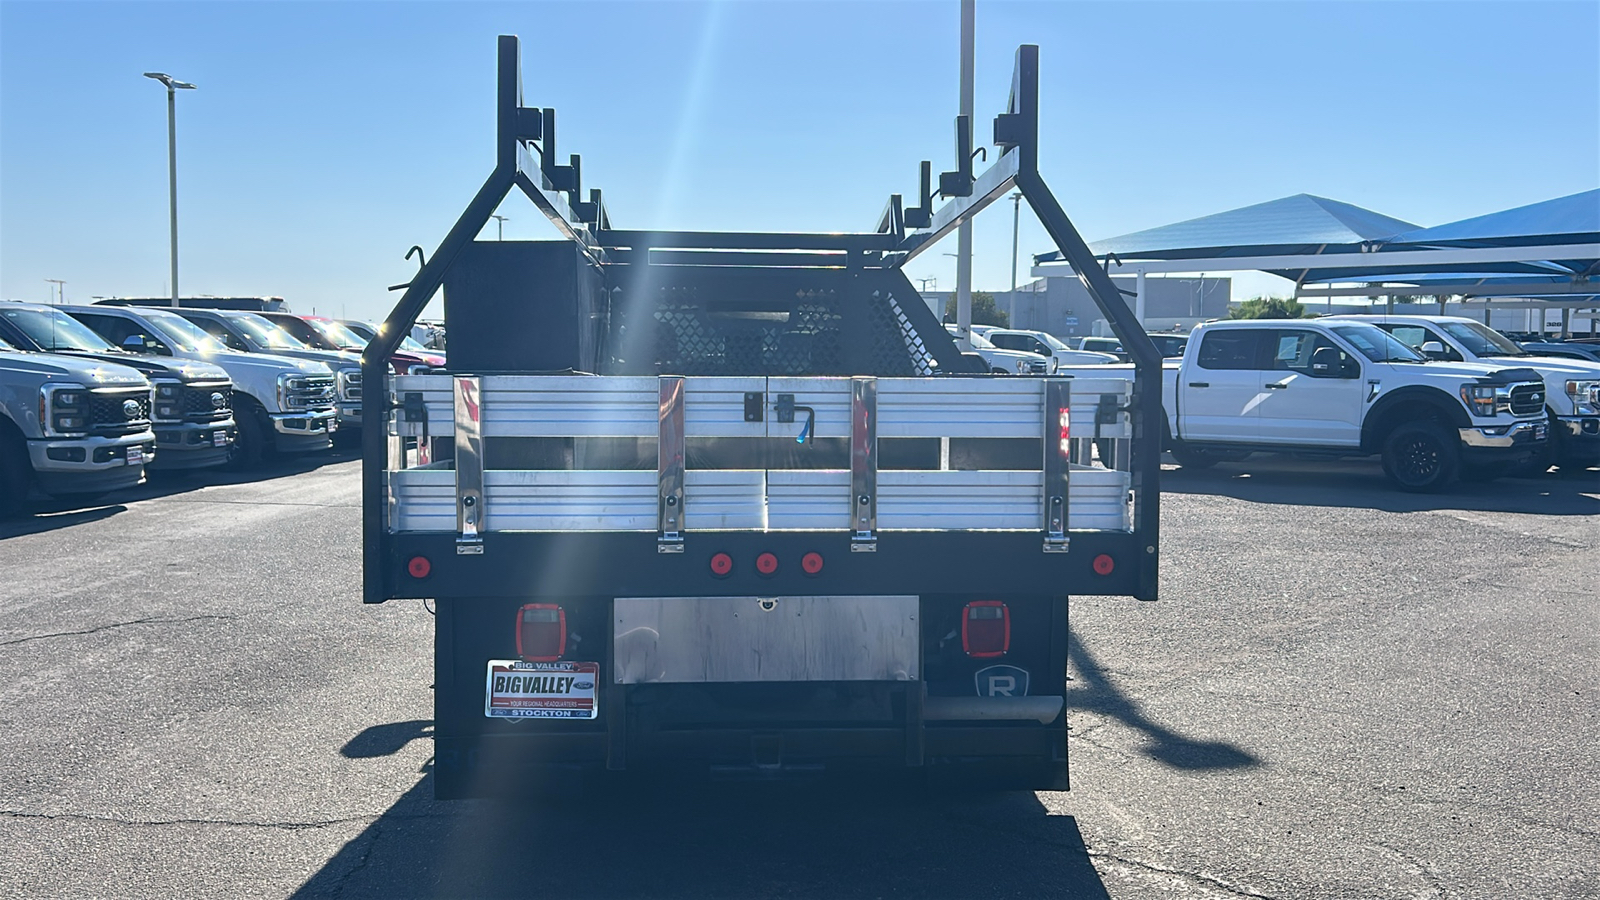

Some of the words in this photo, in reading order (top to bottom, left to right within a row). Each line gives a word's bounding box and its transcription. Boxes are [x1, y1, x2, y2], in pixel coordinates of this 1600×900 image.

[495, 676, 575, 694] BIGVALLEY
[988, 675, 1016, 697] R
[511, 709, 571, 717] STOCKTON
